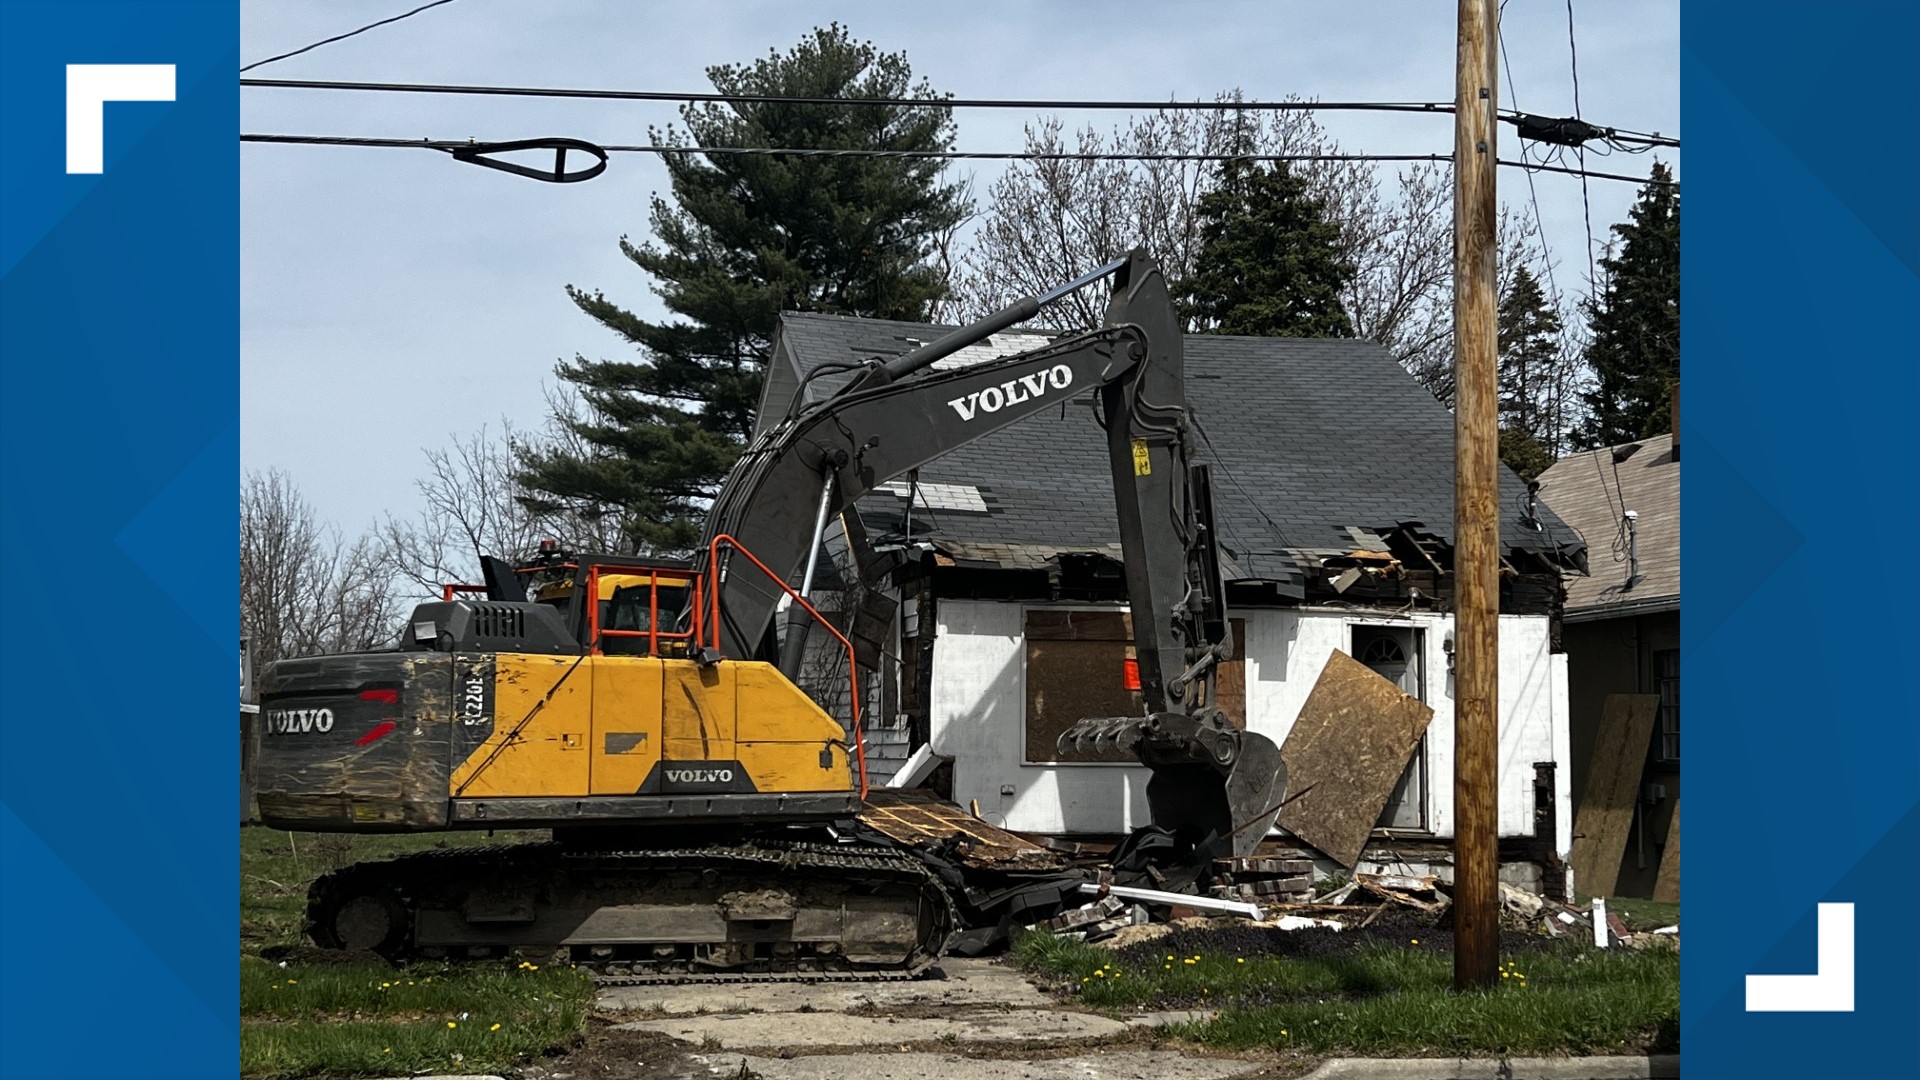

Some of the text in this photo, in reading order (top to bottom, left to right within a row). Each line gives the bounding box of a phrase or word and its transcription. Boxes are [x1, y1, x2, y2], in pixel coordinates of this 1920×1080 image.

[947, 364, 1073, 421] VOLVO
[266, 708, 334, 734] VOLVO
[665, 769, 733, 783] VOLVO
